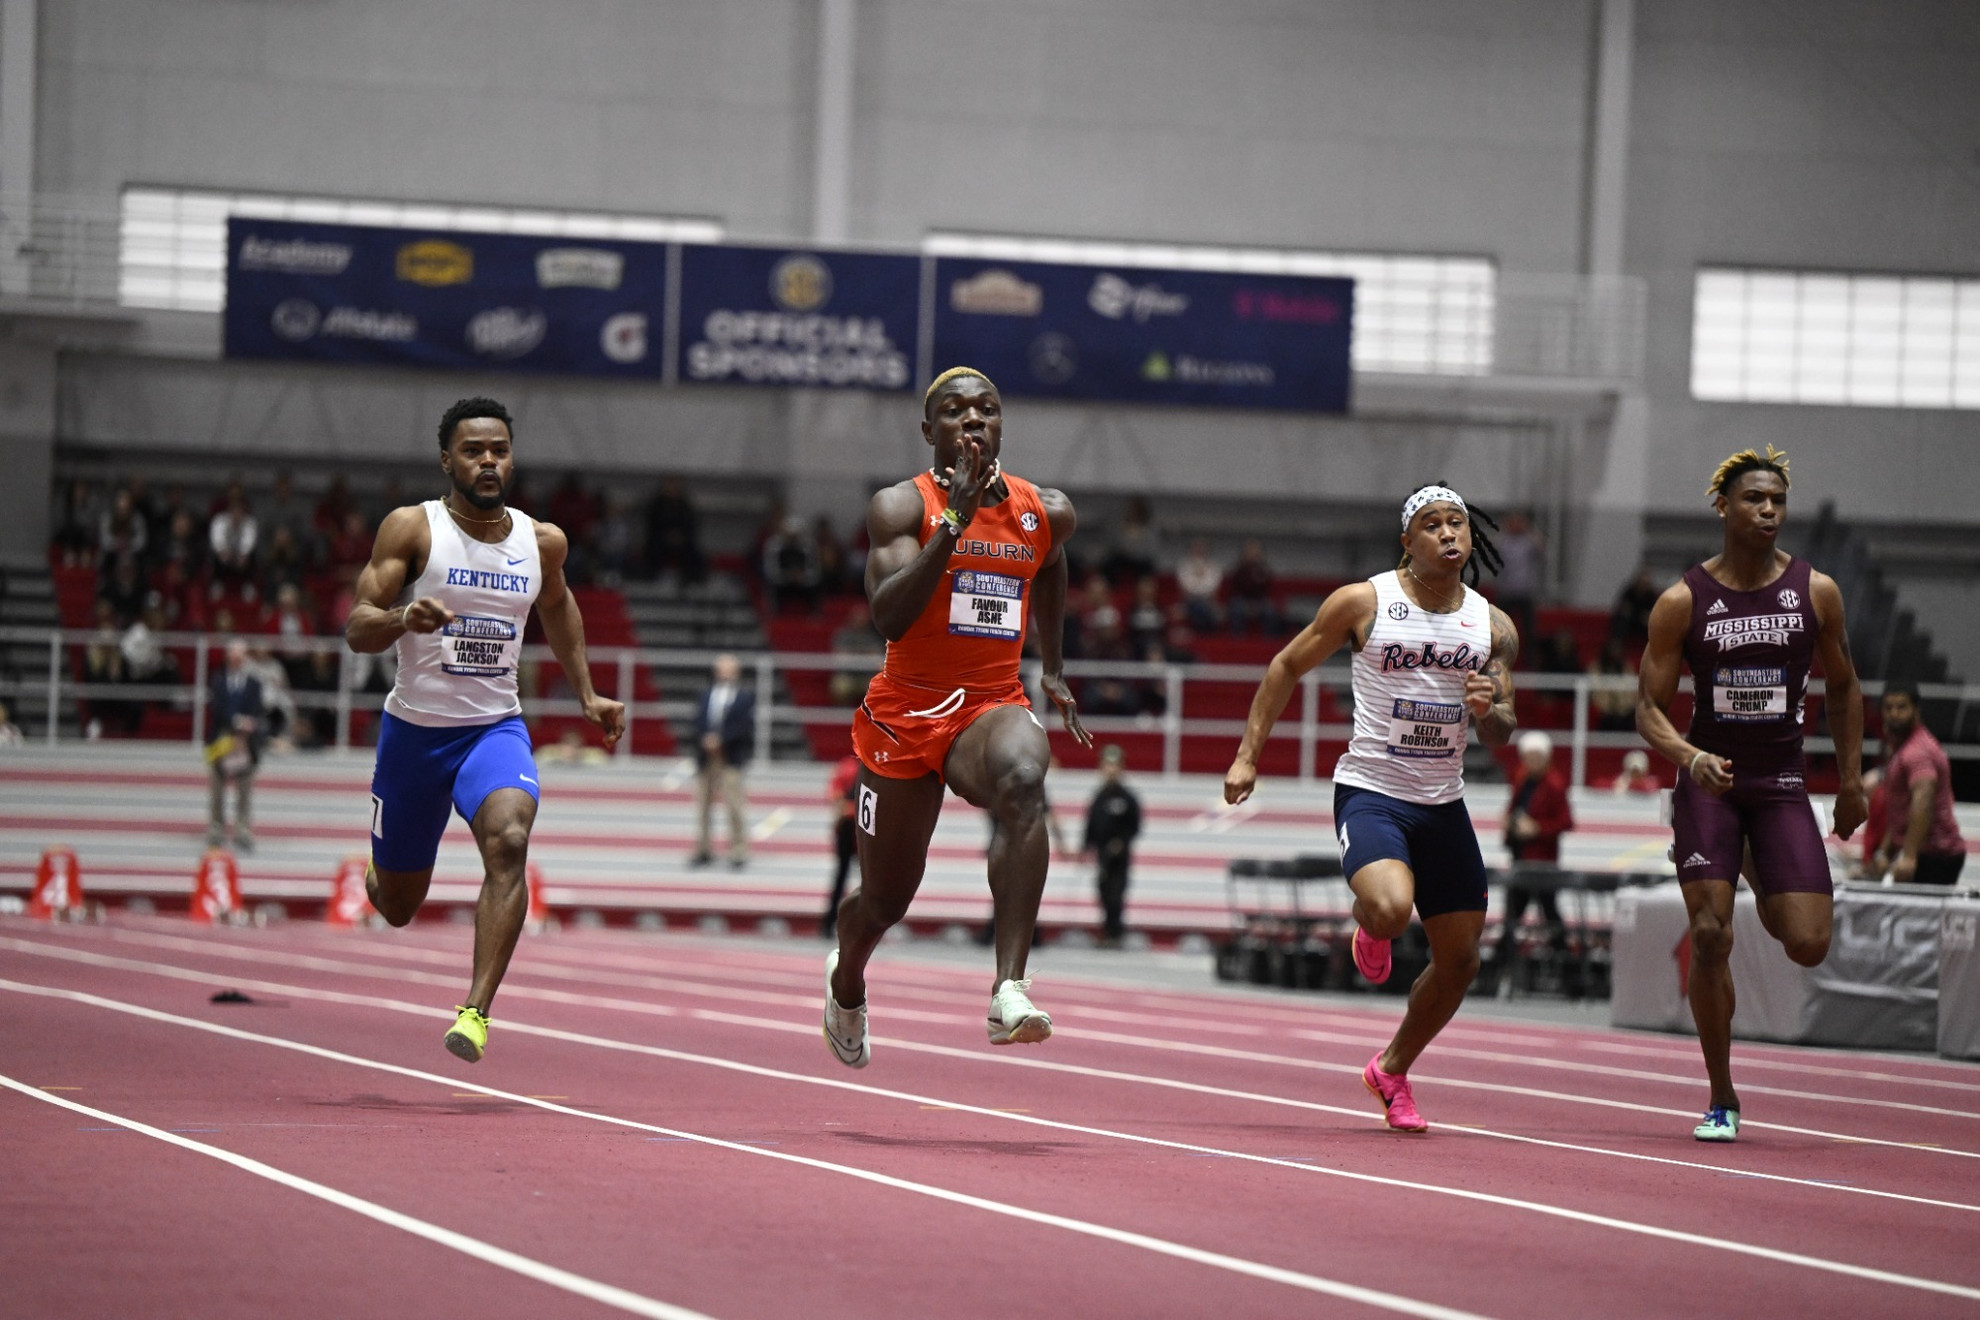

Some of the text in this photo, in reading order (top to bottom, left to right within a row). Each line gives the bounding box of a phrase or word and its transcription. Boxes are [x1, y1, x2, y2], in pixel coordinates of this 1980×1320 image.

[705, 309, 894, 350] OFFICIAL
[688, 341, 908, 388] SPONSORS
[1021, 512, 1038, 531] SEC
[953, 540, 1035, 562] UBURN
[446, 568, 529, 593] KENTUCKY
[976, 574, 1020, 586] SOUTHEASTERN
[975, 582, 1018, 594] CONFERENCE
[971, 598, 1008, 613] FAVOUR
[1778, 589, 1799, 608] SEC
[977, 611, 1002, 625] ASHE
[1389, 603, 1408, 620] SEC
[1704, 616, 1804, 638] MISSISSIPPI
[454, 640, 504, 654] LANGSTON
[1730, 632, 1778, 647] STATE
[456, 652, 499, 665] JACKSON
[1382, 641, 1480, 673] Rebels
[1733, 675, 1781, 683] CONFERENCE
[1726, 690, 1774, 701] CAMERON
[1732, 701, 1768, 712] CRUMP
[1414, 724, 1442, 737] KEITH
[1401, 734, 1449, 747] ROBINSON
[861, 791, 872, 831] 6
